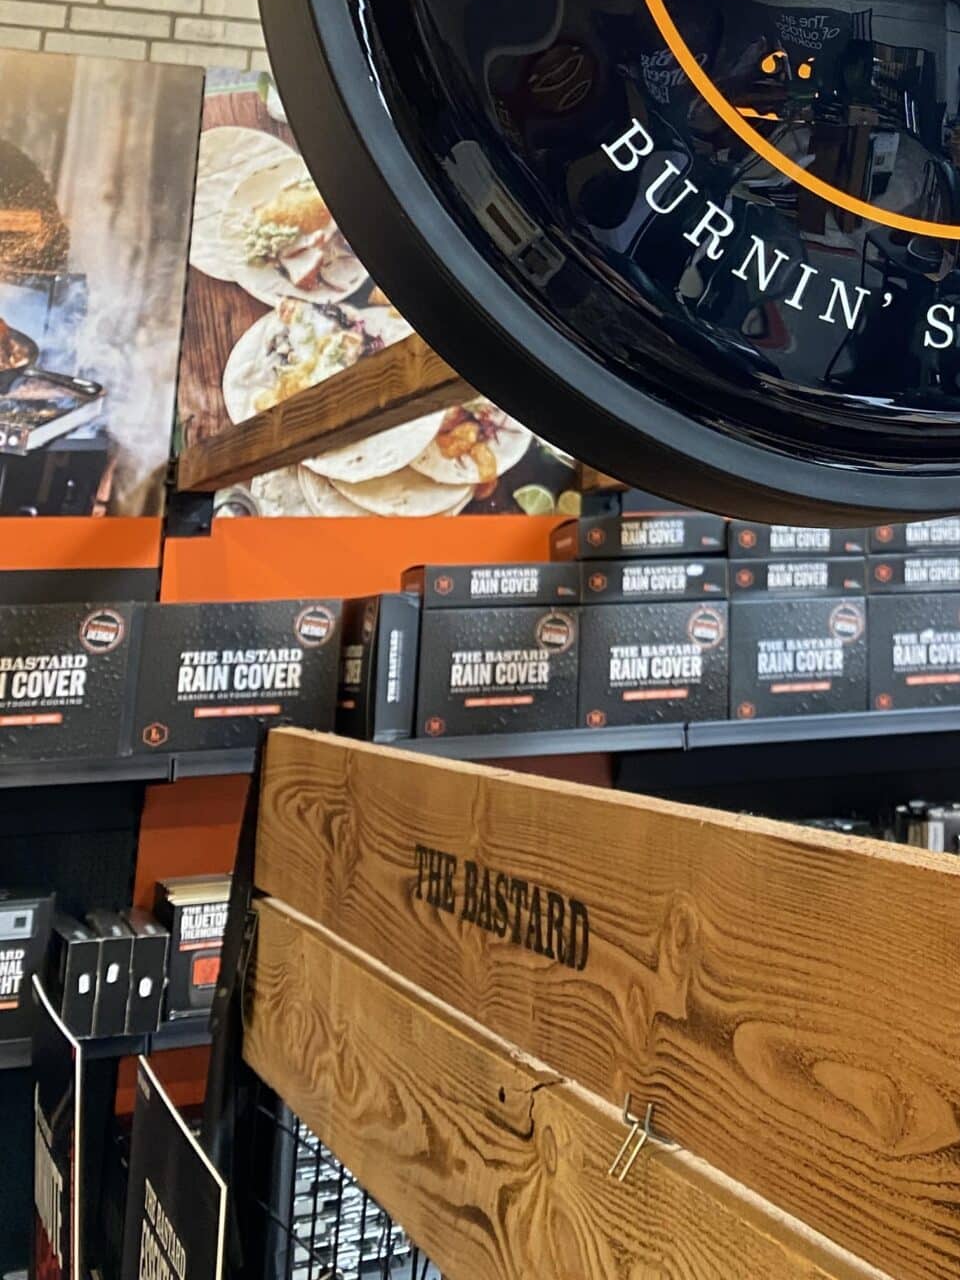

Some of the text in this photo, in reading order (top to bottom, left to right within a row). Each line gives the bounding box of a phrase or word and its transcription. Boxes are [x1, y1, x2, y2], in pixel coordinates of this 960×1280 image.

[470, 577, 539, 595] RAIN COVER
[609, 644, 702, 658] THE BASTARD
[757, 637, 843, 652] THE BASTARD
[0, 654, 89, 671] BASTARD
[180, 648, 303, 666] THE BASTARD
[452, 648, 549, 664] THE BASTARD
[757, 649, 844, 674] RAIN COVER
[892, 645, 928, 666] RAIN
[177, 663, 303, 693] RAIN COVER
[450, 661, 550, 687] RAIN COVER
[609, 656, 703, 681] RAIN COVER
[11, 670, 87, 699] COVER
[414, 843, 590, 972] THE BASTARD
